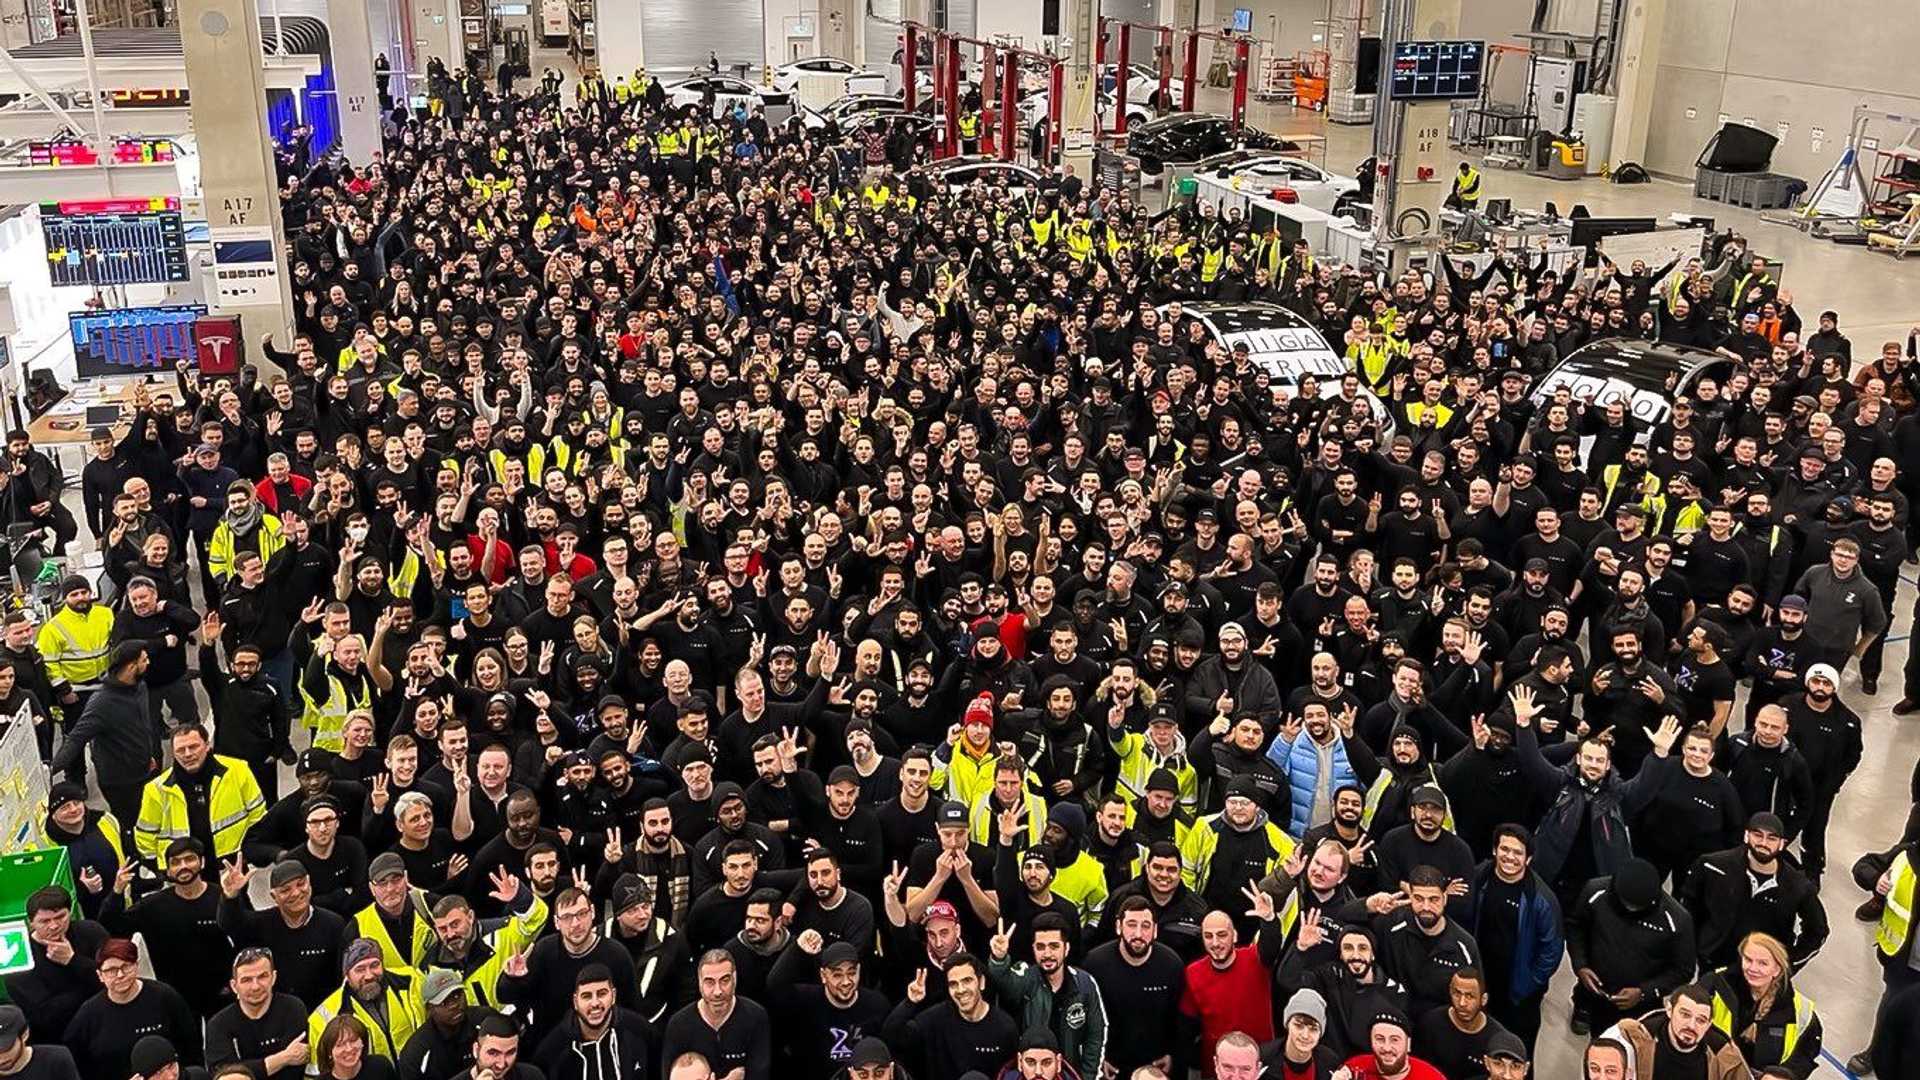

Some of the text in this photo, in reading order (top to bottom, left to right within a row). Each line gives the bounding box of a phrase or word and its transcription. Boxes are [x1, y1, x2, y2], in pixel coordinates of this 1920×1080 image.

[1419, 128, 1438, 138] A18
[1419, 143, 1432, 152] AF
[224, 198, 252, 210] A17
[230, 212, 246, 225] AF
[1232, 333, 1321, 350] IGA
